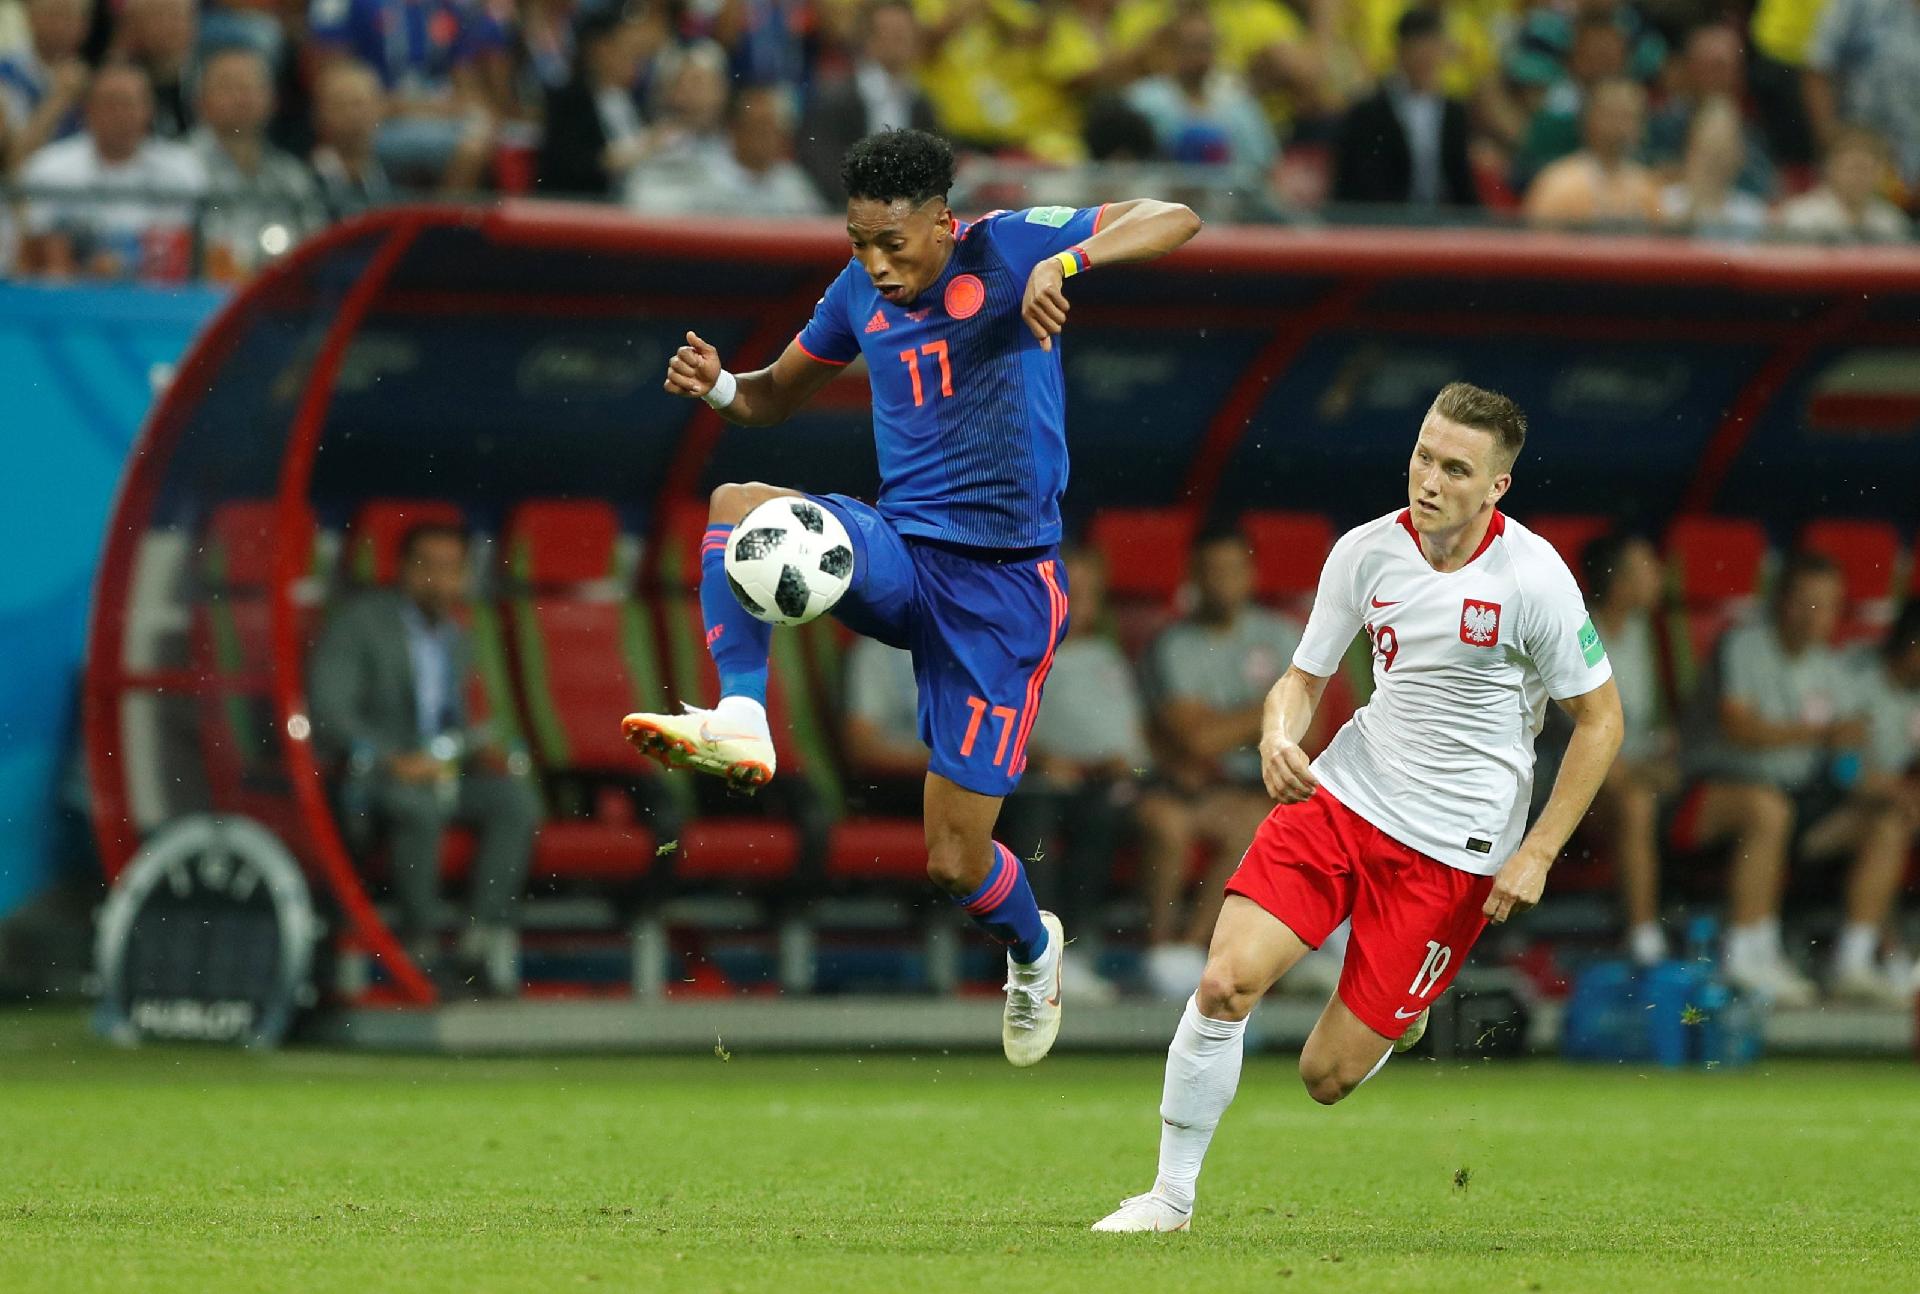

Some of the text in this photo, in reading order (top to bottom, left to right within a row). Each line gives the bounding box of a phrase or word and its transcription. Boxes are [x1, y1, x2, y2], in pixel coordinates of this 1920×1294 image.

[900, 340, 953, 407] 17
[960, 696, 1017, 766] 17
[1409, 940, 1451, 998] 19
